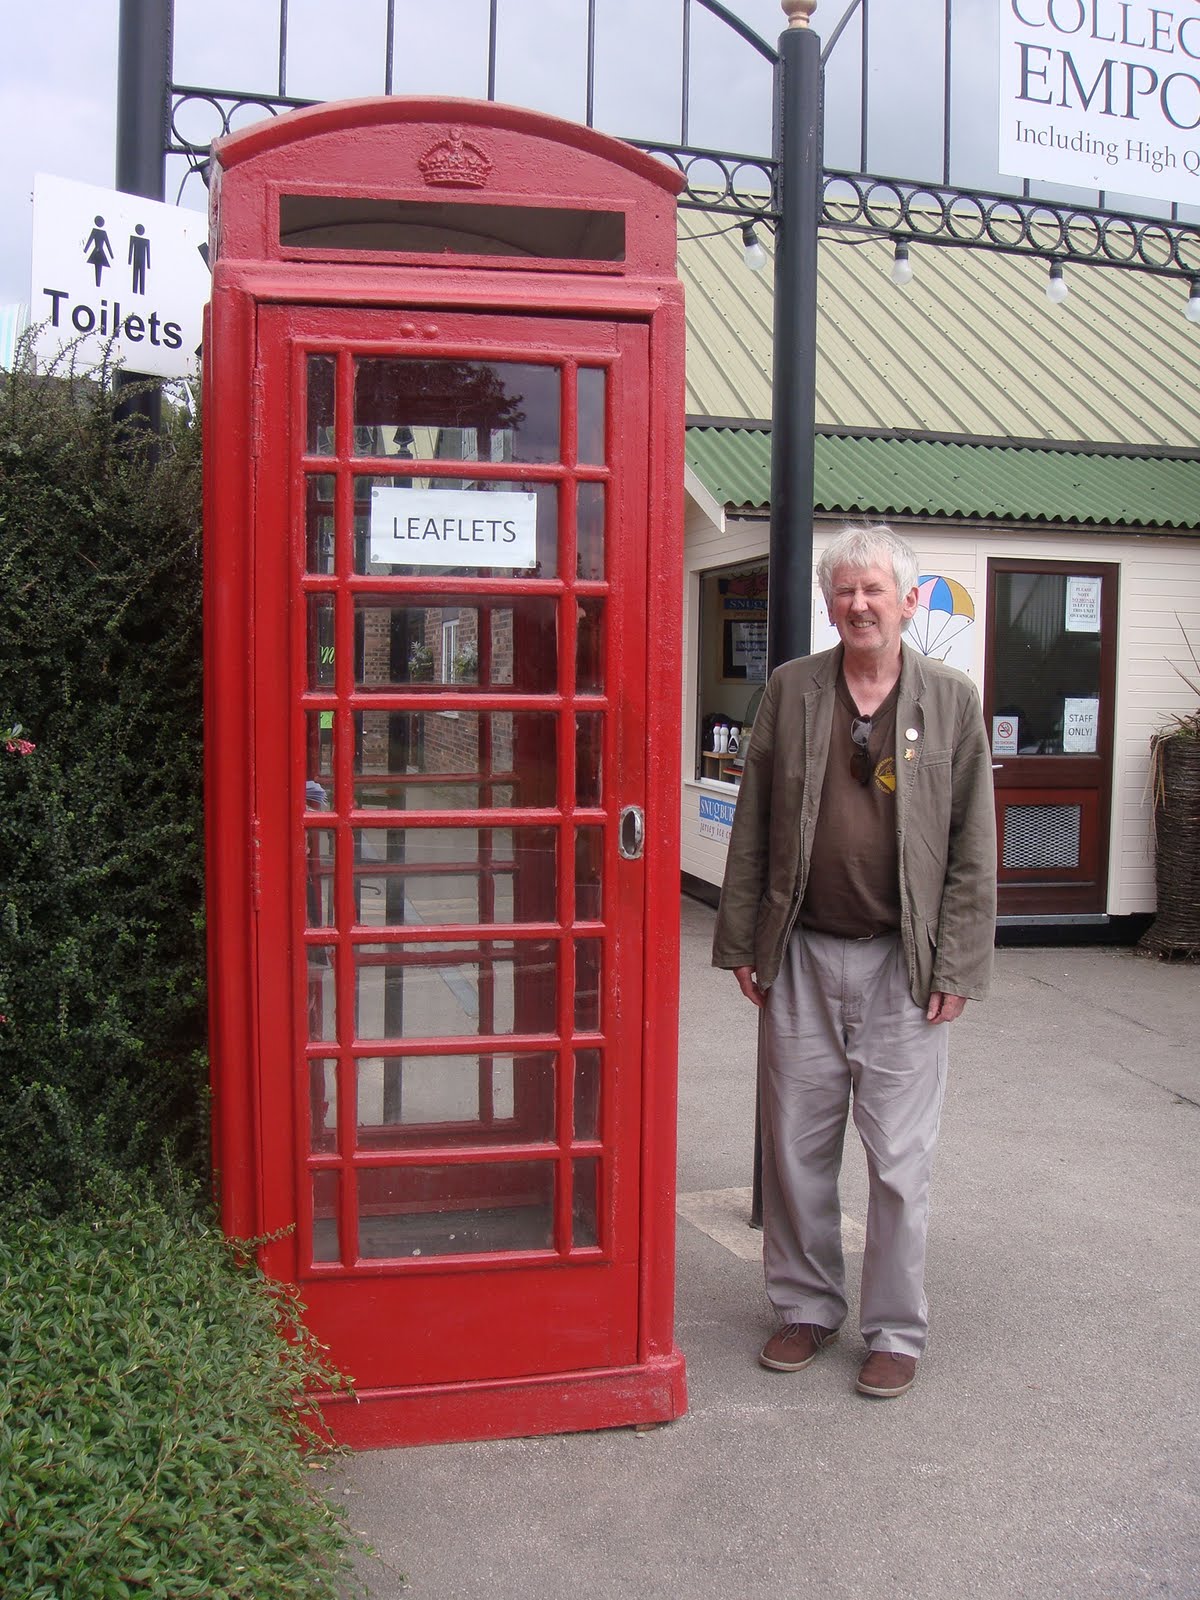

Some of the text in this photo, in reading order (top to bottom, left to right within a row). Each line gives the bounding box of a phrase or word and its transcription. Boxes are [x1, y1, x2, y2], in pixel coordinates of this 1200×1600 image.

[1014, 41, 1200, 130] EMPO
[1016, 120, 1119, 165] Including
[1125, 139, 1177, 173] High
[43, 288, 183, 349] Toilets
[393, 517, 517, 543] LEAFLETS
[1068, 727, 1093, 736] ONLY!
[1069, 714, 1093, 722] STAFF
